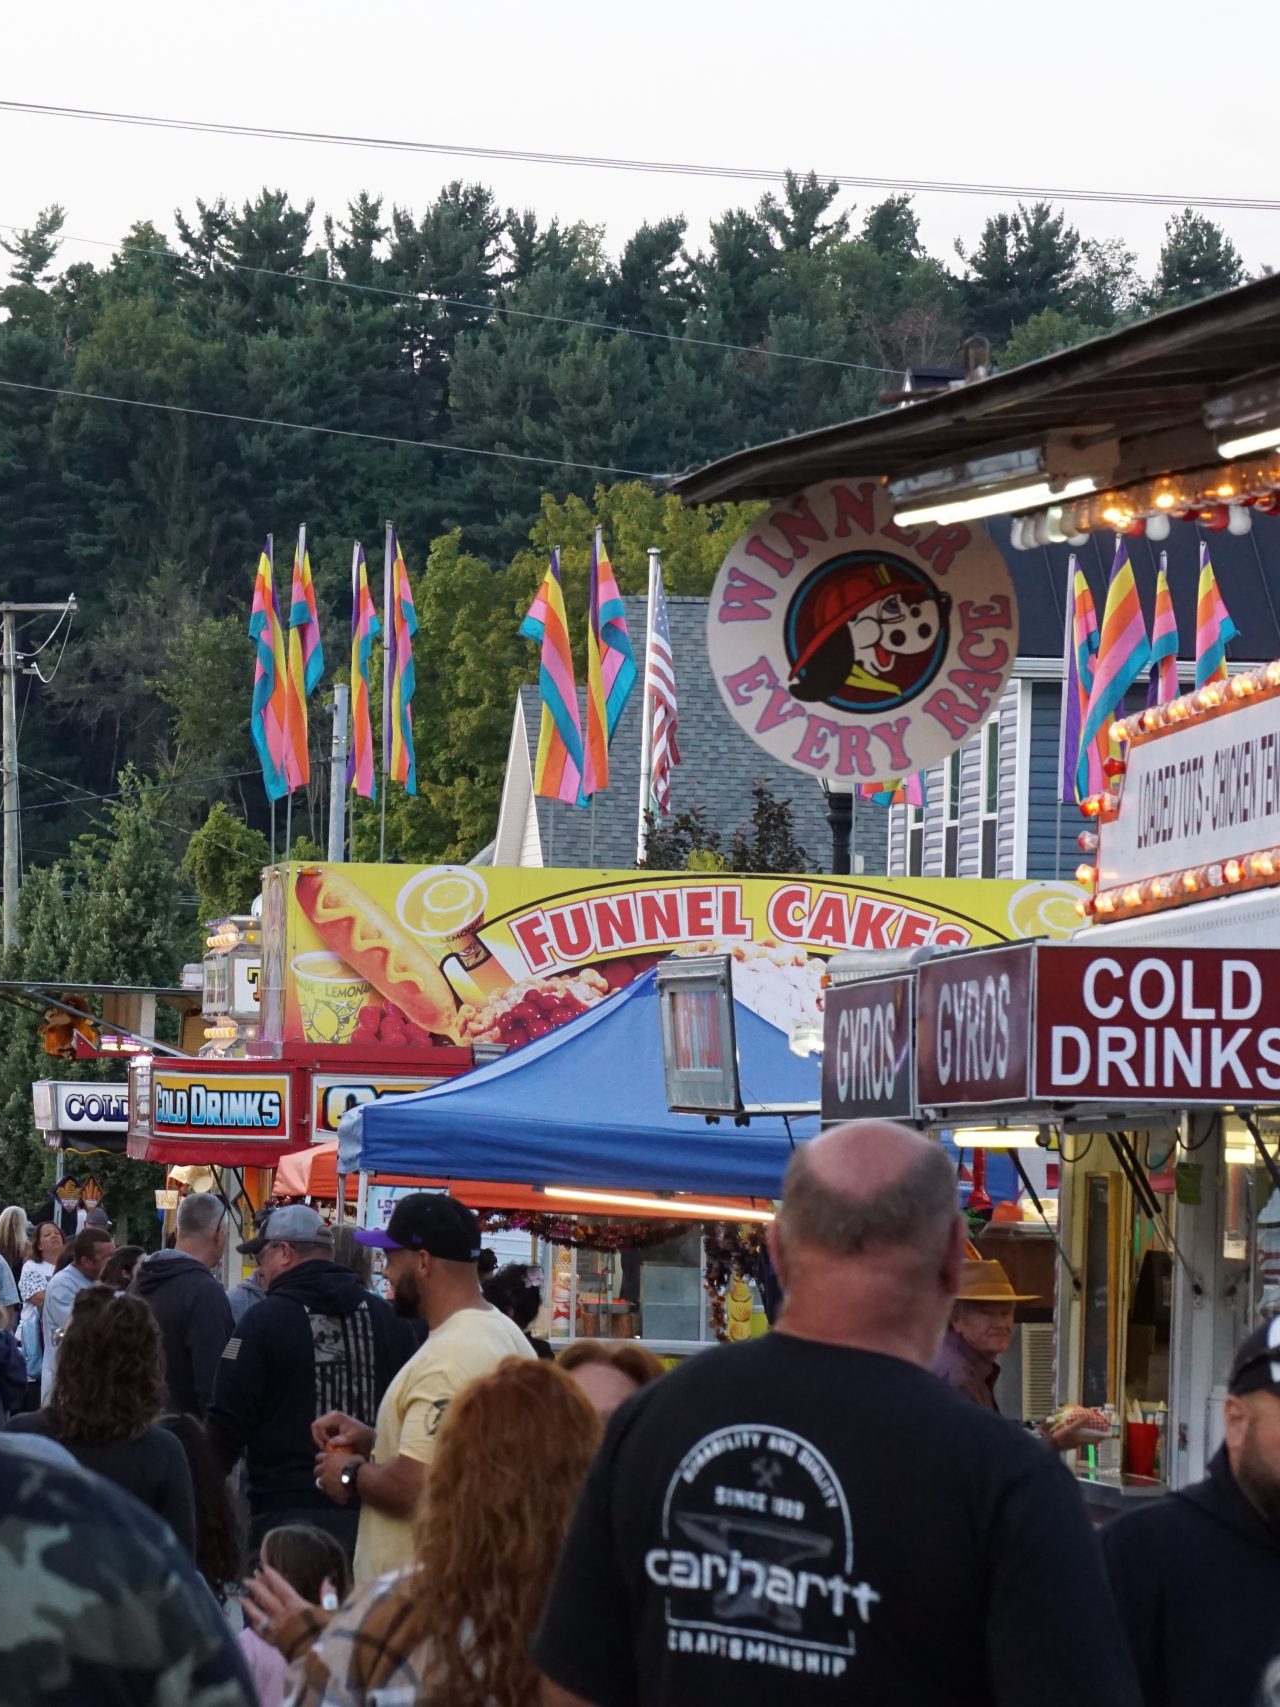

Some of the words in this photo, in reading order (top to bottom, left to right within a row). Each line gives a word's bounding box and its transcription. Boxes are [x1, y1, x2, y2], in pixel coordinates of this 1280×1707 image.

[722, 655, 912, 776] EVERY
[922, 594, 1012, 741] RACE
[1137, 764, 1176, 849] LOADED
[1178, 755, 1204, 839] TOTS
[1212, 743, 1258, 831] CHICKEN
[507, 884, 753, 976] FUNNEL
[1082, 957, 1263, 1020] COLD
[836, 1002, 896, 1103] GYROS
[936, 973, 1011, 1086] GYROS
[1051, 1026, 1280, 1090] DRINKS
[156, 1082, 188, 1124] COLD
[189, 1083, 282, 1128] DRINKS
[714, 1485, 768, 1513] SINCE
[645, 1548, 881, 1624] carhartt
[667, 1629, 848, 1678] CRAFTSMANSHIP
